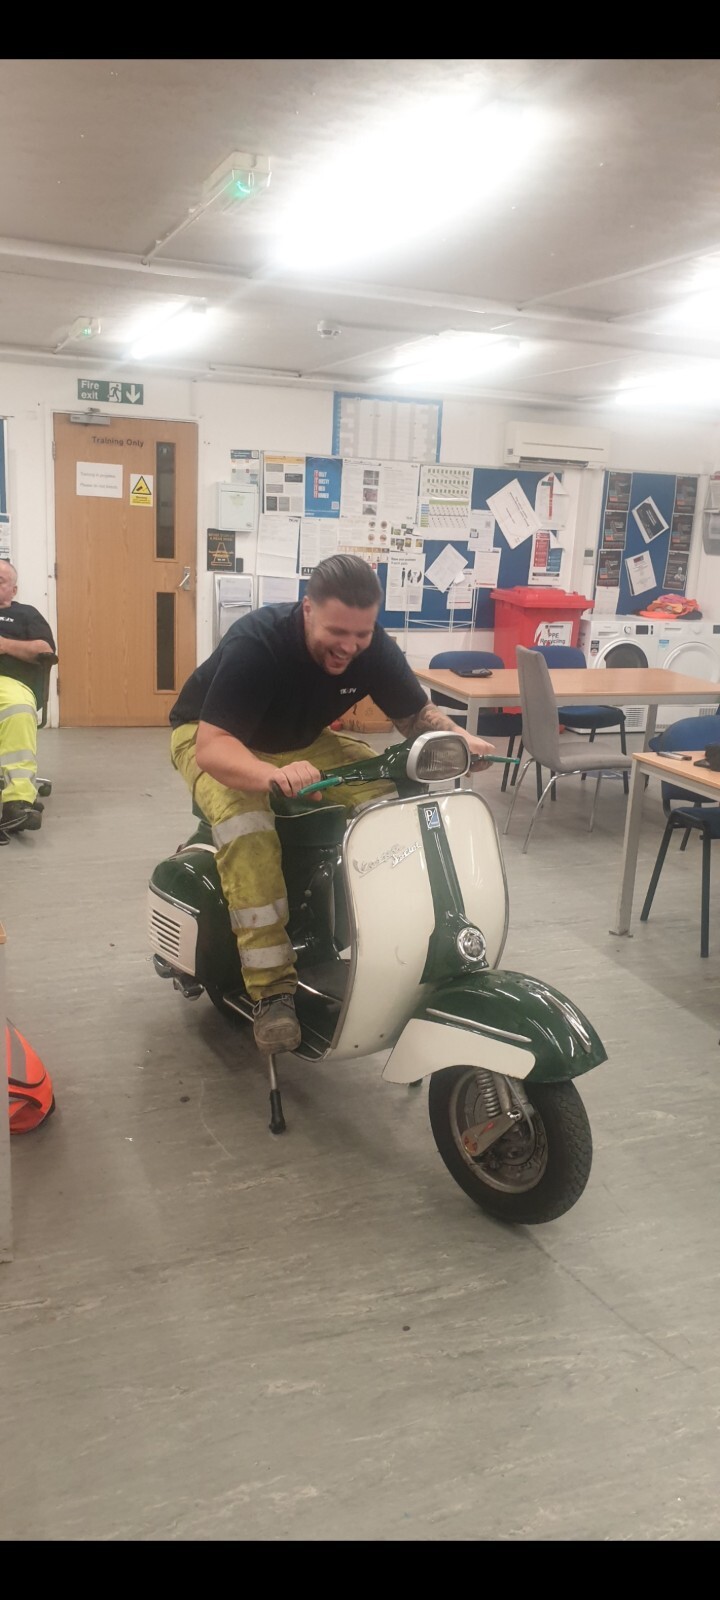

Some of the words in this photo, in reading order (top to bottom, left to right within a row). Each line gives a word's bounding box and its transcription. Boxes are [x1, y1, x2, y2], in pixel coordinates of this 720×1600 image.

[81, 380, 100, 390] Fire
[81, 391, 99, 400] exit
[92, 436, 123, 447] Training
[126, 438, 144, 448] Only
